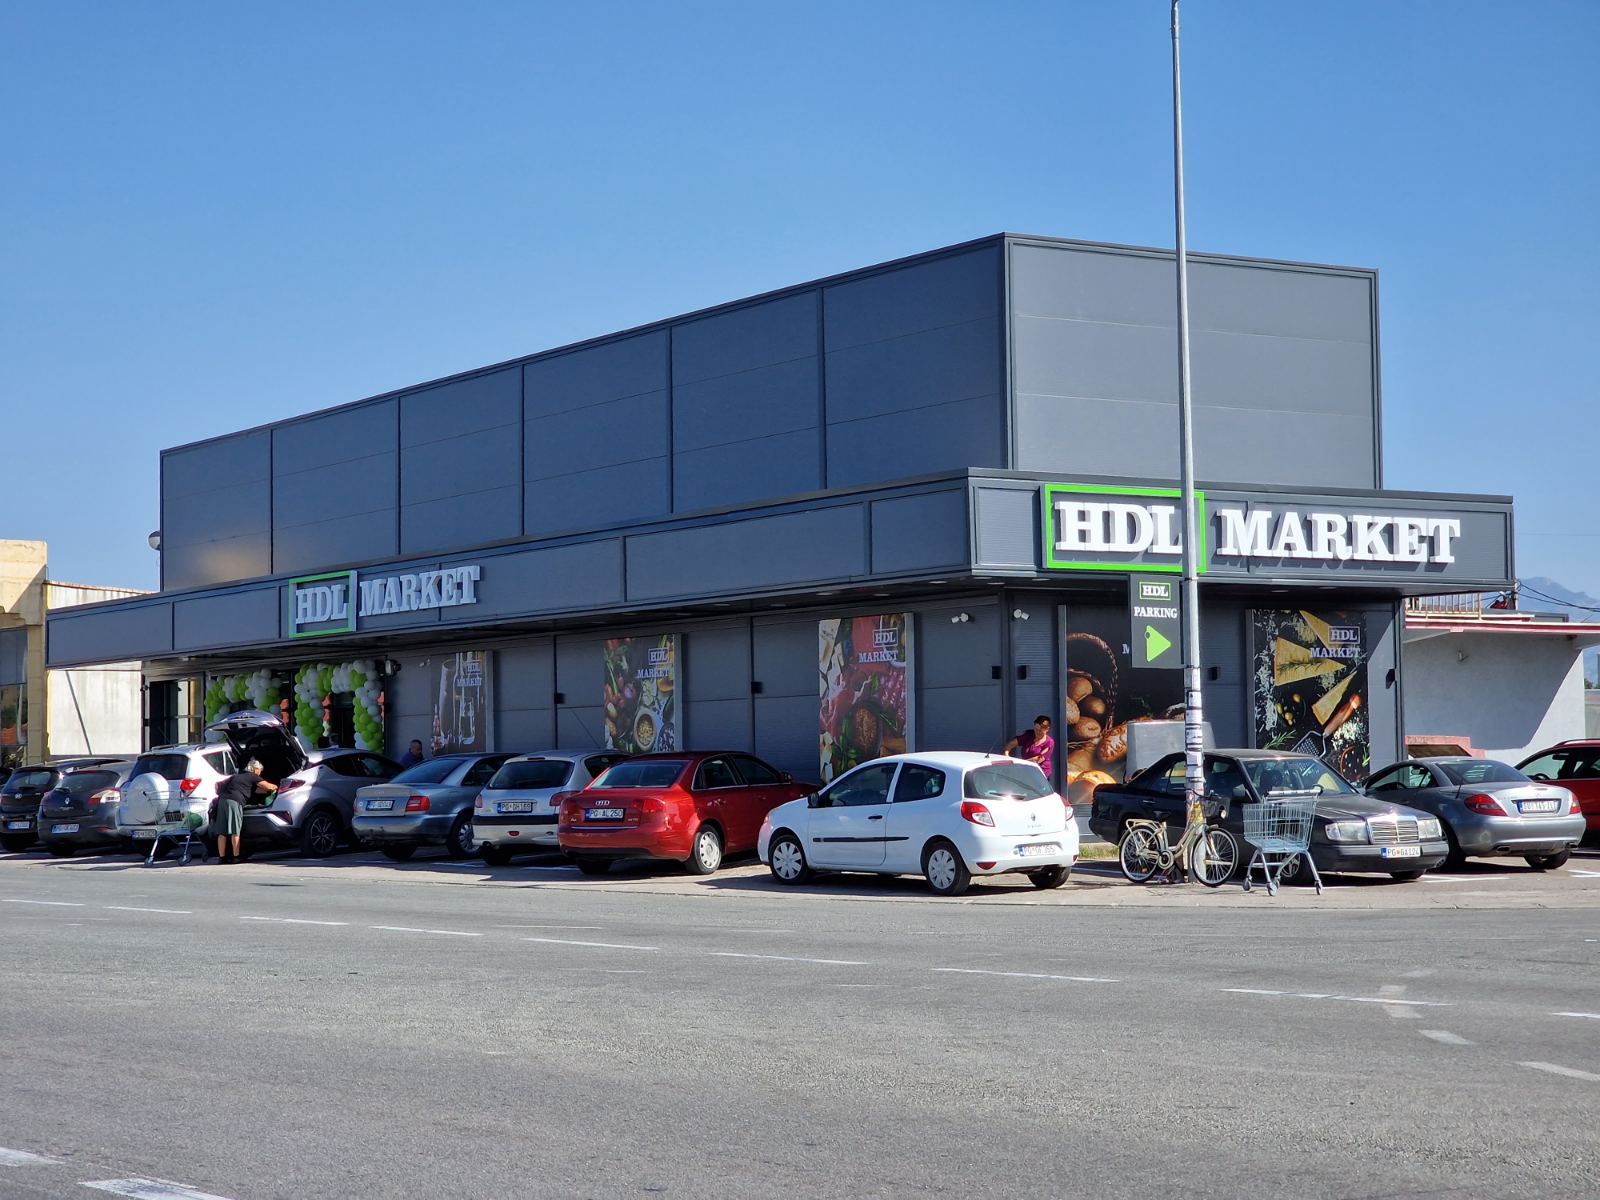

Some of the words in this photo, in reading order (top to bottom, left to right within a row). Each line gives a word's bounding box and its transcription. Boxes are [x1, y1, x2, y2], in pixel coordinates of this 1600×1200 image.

[1055, 501, 1182, 553] HDL
[1216, 509, 1460, 563] MARKET
[296, 584, 348, 624] HDL
[359, 565, 480, 617] MARKET
[1142, 585, 1168, 597] HDL
[1134, 606, 1178, 618] PARKING
[875, 632, 896, 644] HDL
[1330, 629, 1357, 640] HDL
[859, 651, 898, 663] MARKET
[1310, 647, 1360, 658] MARKET
[637, 668, 669, 678] MARKET
